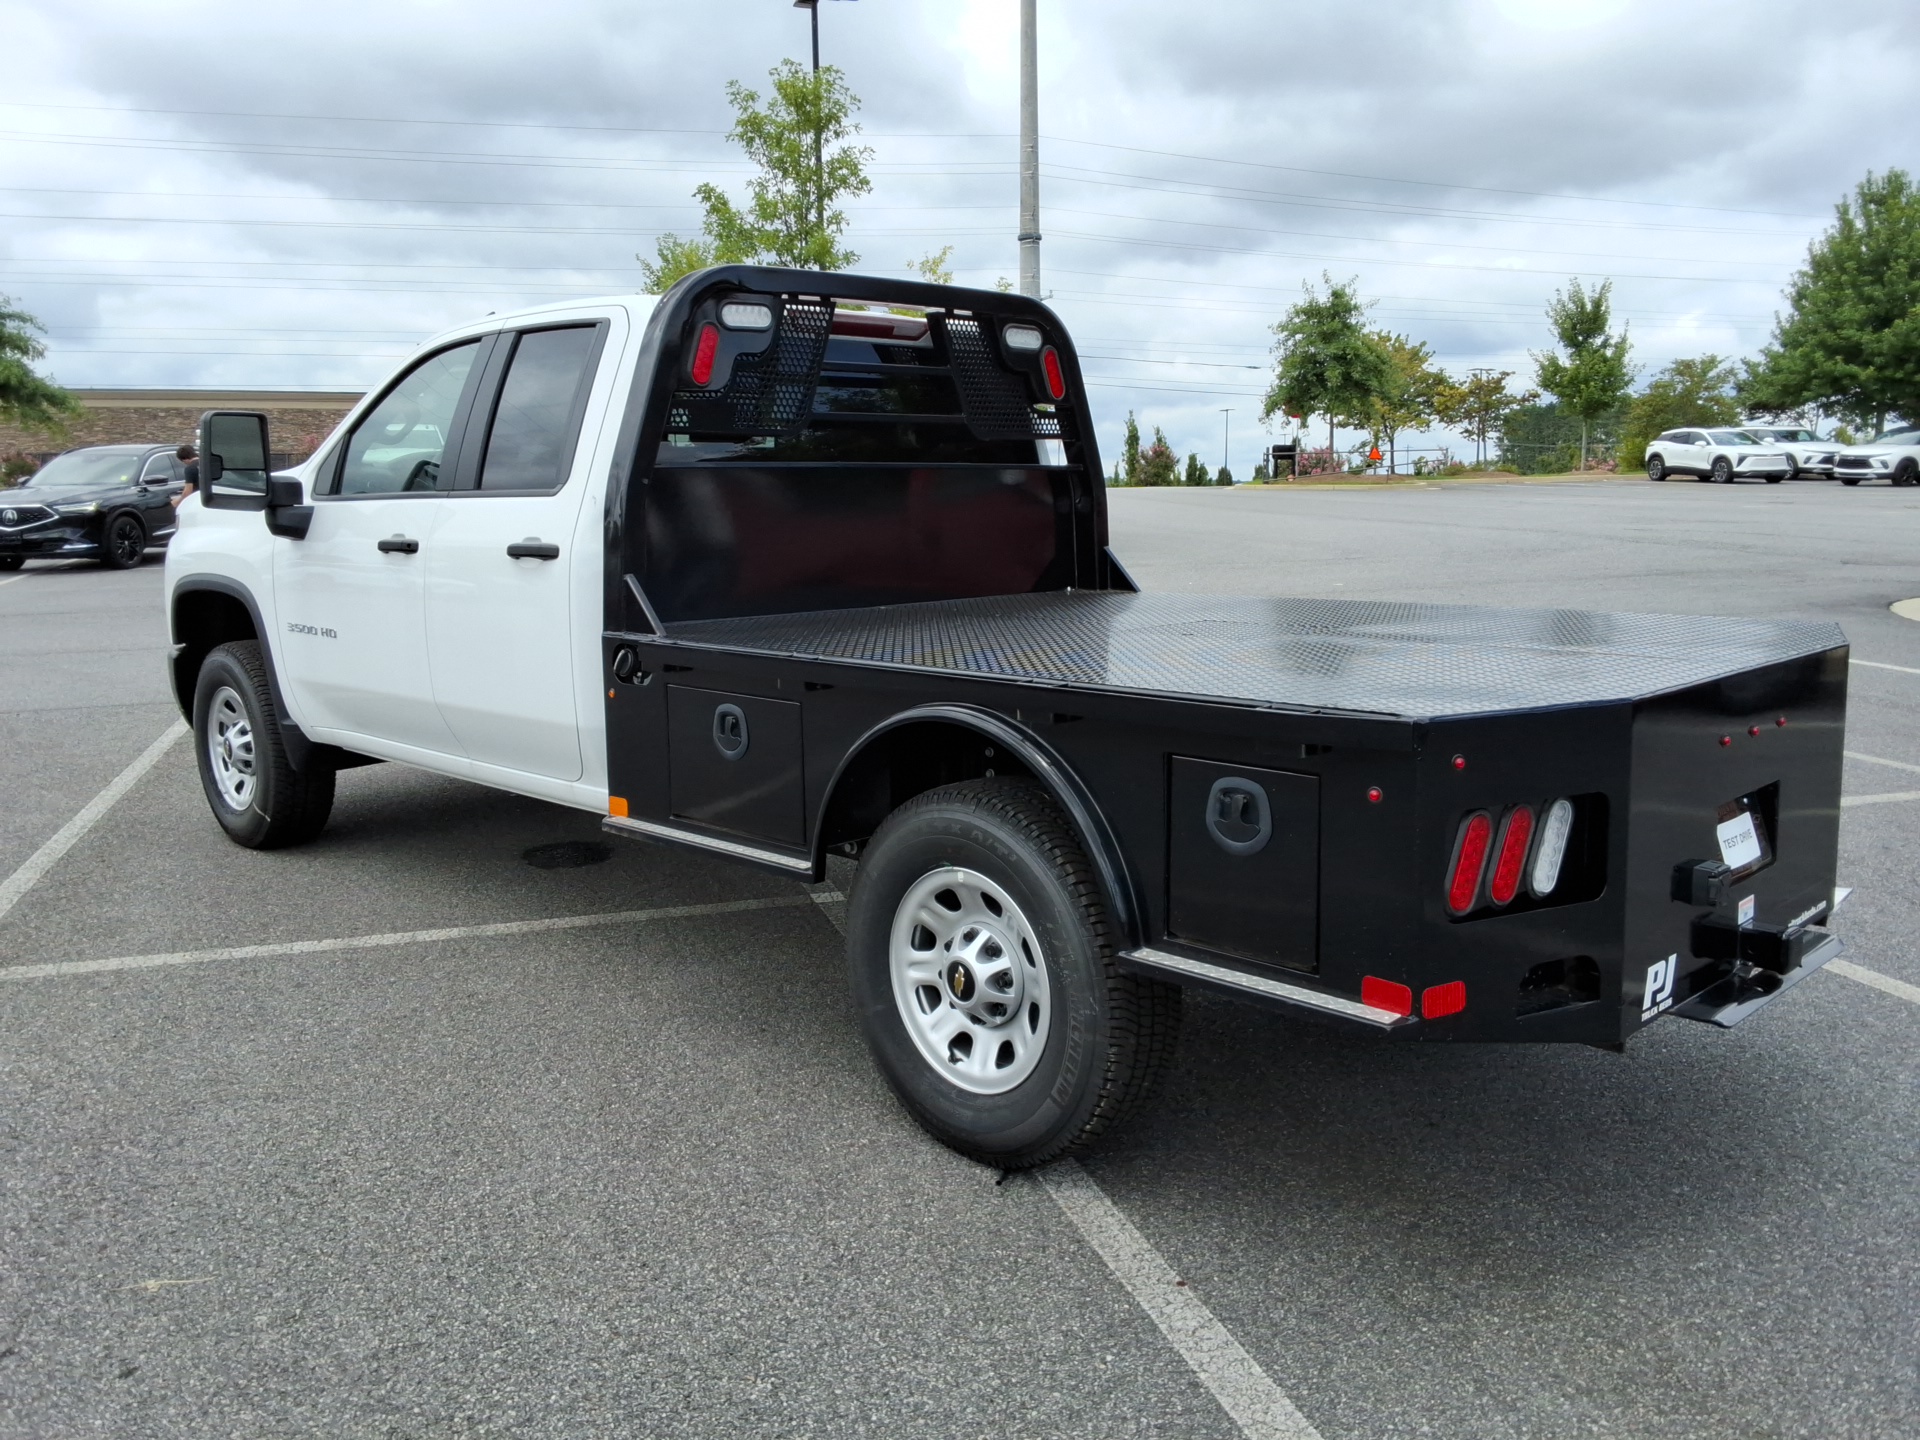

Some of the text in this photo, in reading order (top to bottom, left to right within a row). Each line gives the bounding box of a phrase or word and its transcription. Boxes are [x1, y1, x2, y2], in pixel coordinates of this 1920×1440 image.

[287, 622, 337, 639] 3500 HD
[1723, 828, 1753, 850] TEST DRIVE
[1642, 952, 1678, 1011] PJ
